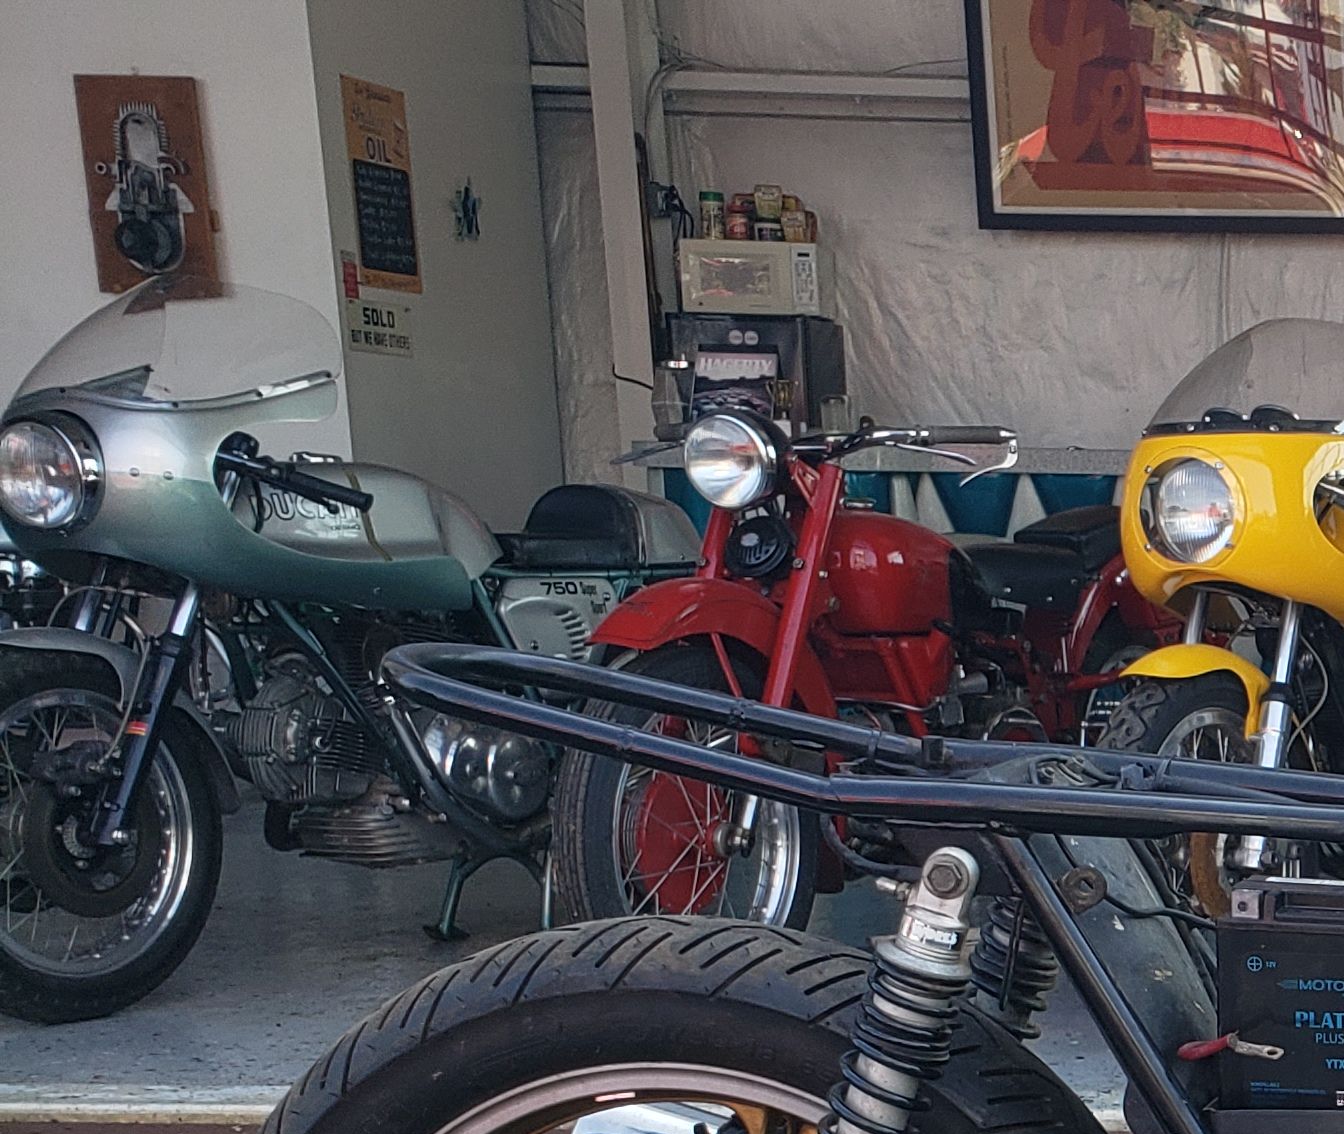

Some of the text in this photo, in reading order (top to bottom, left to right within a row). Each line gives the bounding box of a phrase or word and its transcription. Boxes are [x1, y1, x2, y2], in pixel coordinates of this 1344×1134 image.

[367, 137, 391, 163] OIL
[362, 306, 395, 328] SOLD
[363, 331, 373, 346] WE
[700, 357, 772, 372] HAGERTY
[540, 581, 578, 596] 750
[1315, 1032, 1344, 1046] PLUS
